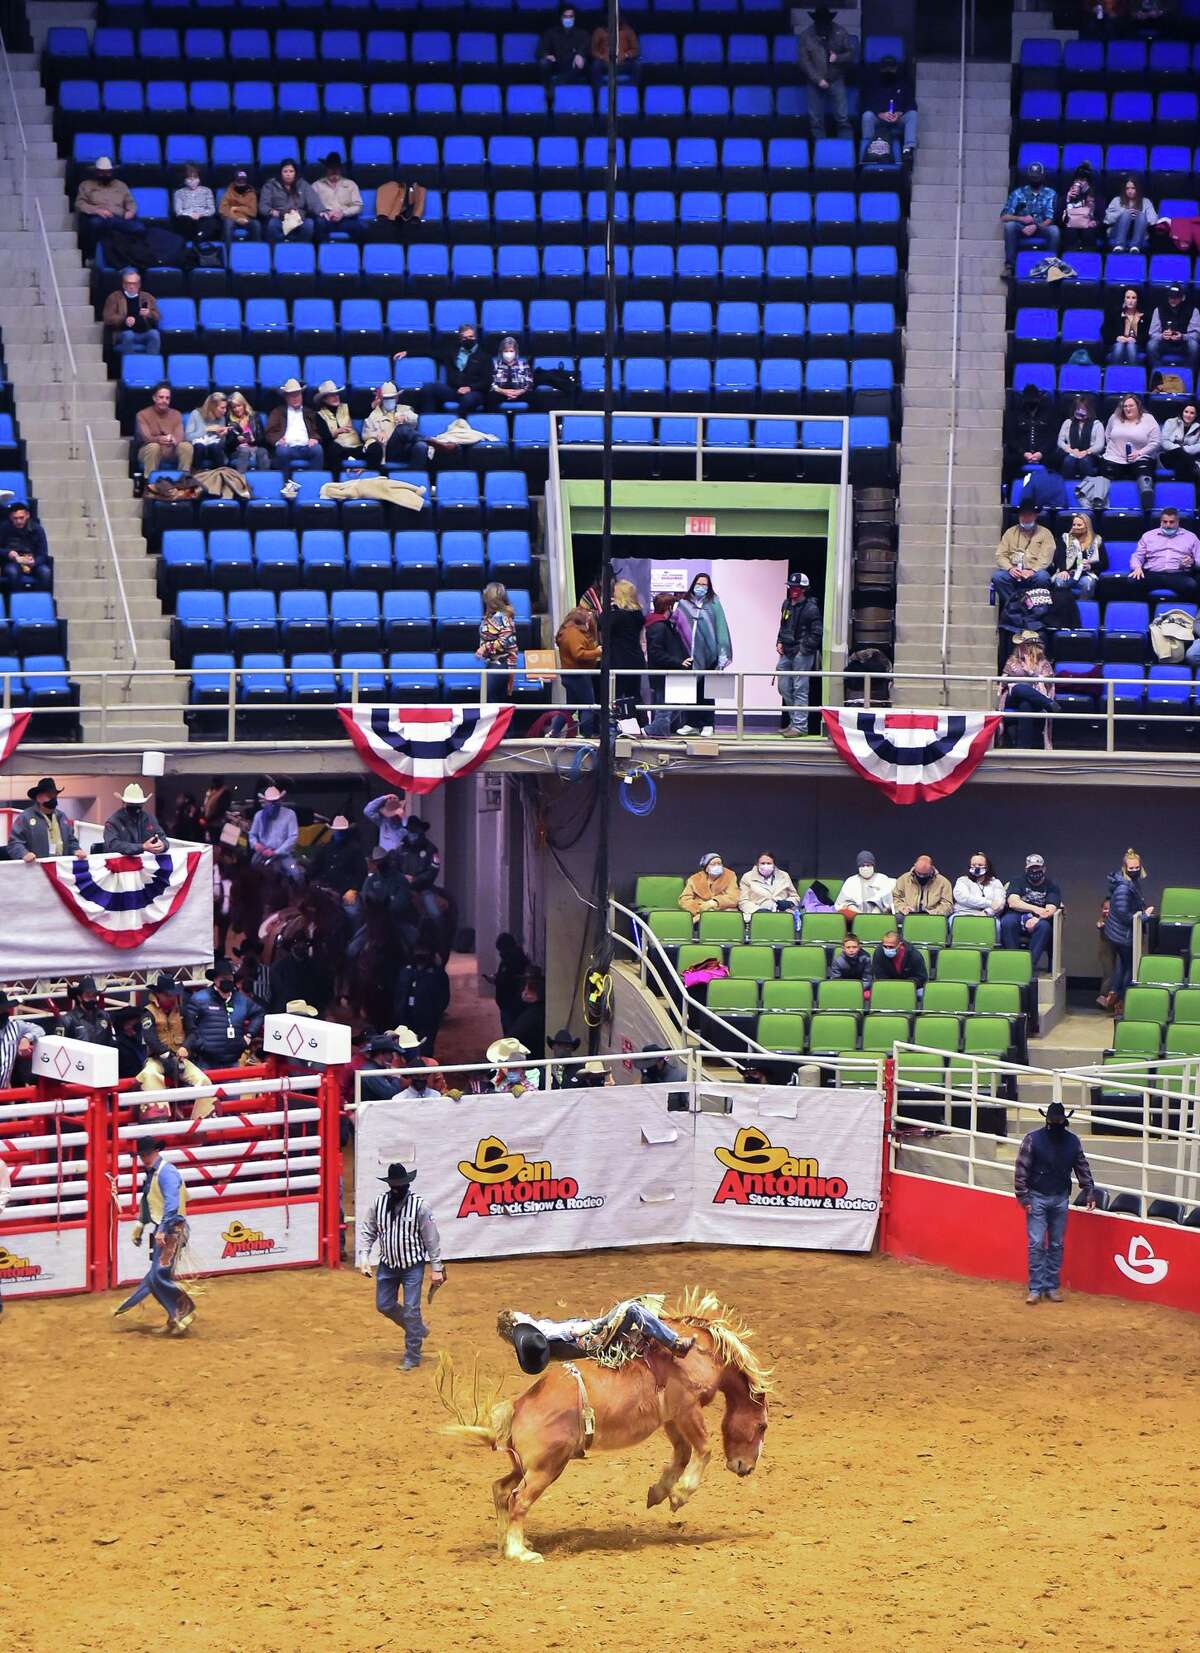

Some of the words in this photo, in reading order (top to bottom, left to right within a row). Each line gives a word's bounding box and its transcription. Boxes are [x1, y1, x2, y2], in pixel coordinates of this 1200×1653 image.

[688, 515, 713, 533] EXIT
[457, 1135, 552, 1183] San
[714, 1126, 818, 1178] San
[456, 1177, 579, 1219] Antonio
[712, 1169, 848, 1204] Antonio
[748, 1194, 785, 1206] Stock
[786, 1195, 822, 1208] Show
[823, 1198, 833, 1208] &
[834, 1198, 877, 1211] Rodeo
[523, 1200, 555, 1213] Show
[555, 1198, 565, 1210] &
[566, 1197, 603, 1209] Rodeo
